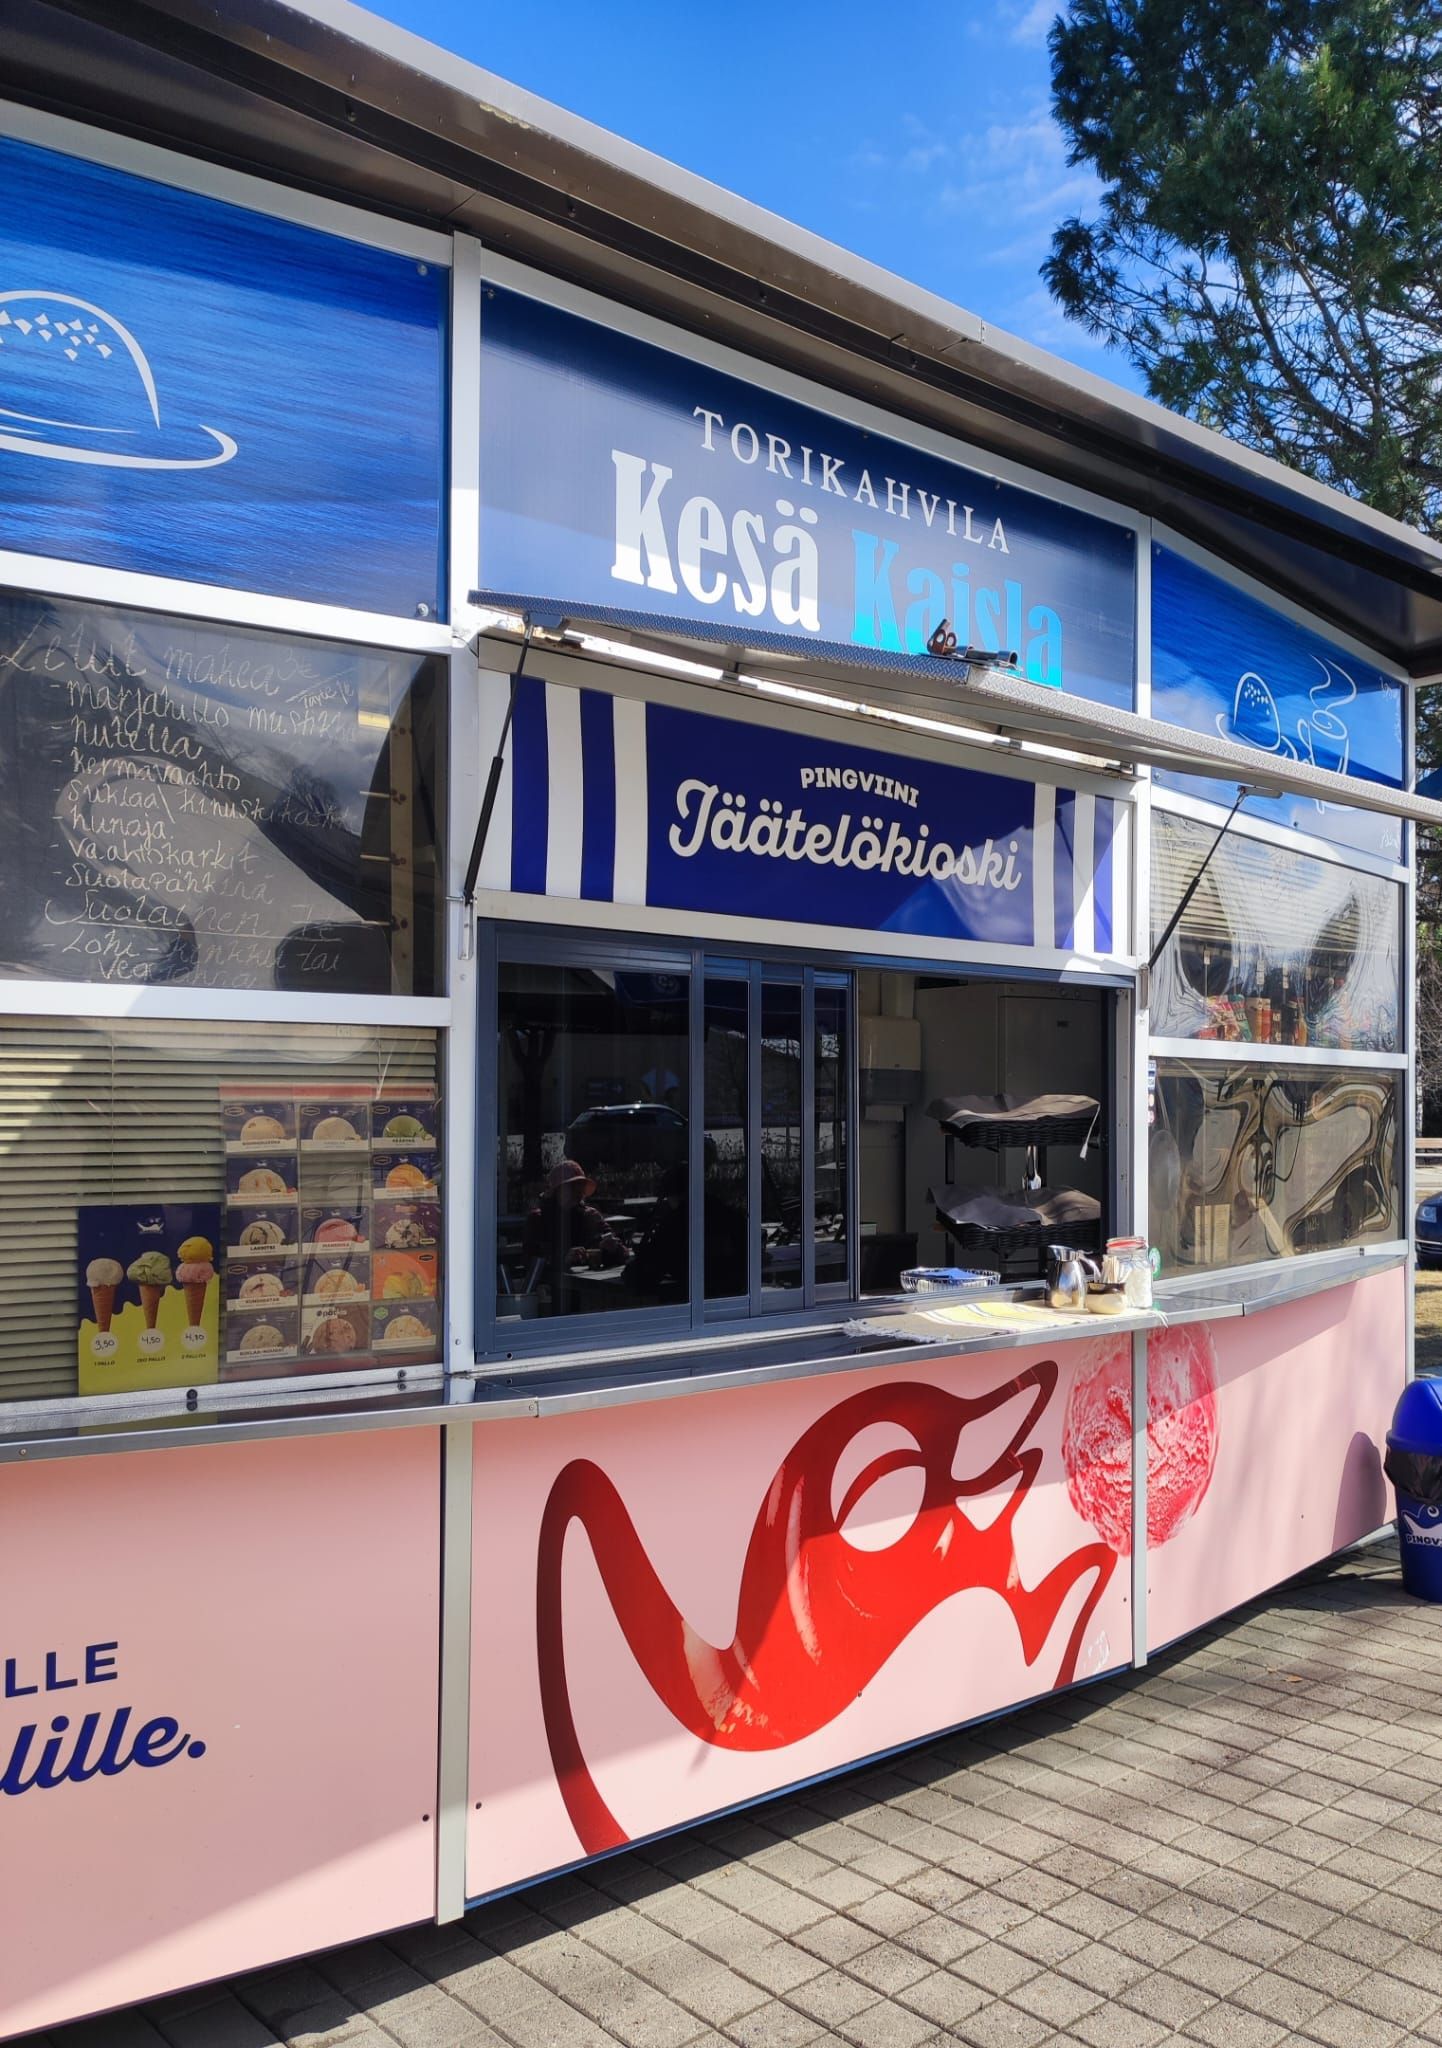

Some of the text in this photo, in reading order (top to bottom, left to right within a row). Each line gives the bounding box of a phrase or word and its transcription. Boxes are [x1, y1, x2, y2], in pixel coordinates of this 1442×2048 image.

[693, 406, 1010, 554] TORIKAHVILA
[611, 449, 1064, 690] Kesä Kaisla
[800, 767, 919, 808] PINGVIINI
[669, 779, 1022, 890] Jäätelökioski
[1407, 1534, 1442, 1547] PINGV
[5, 1641, 118, 1698] LLE
